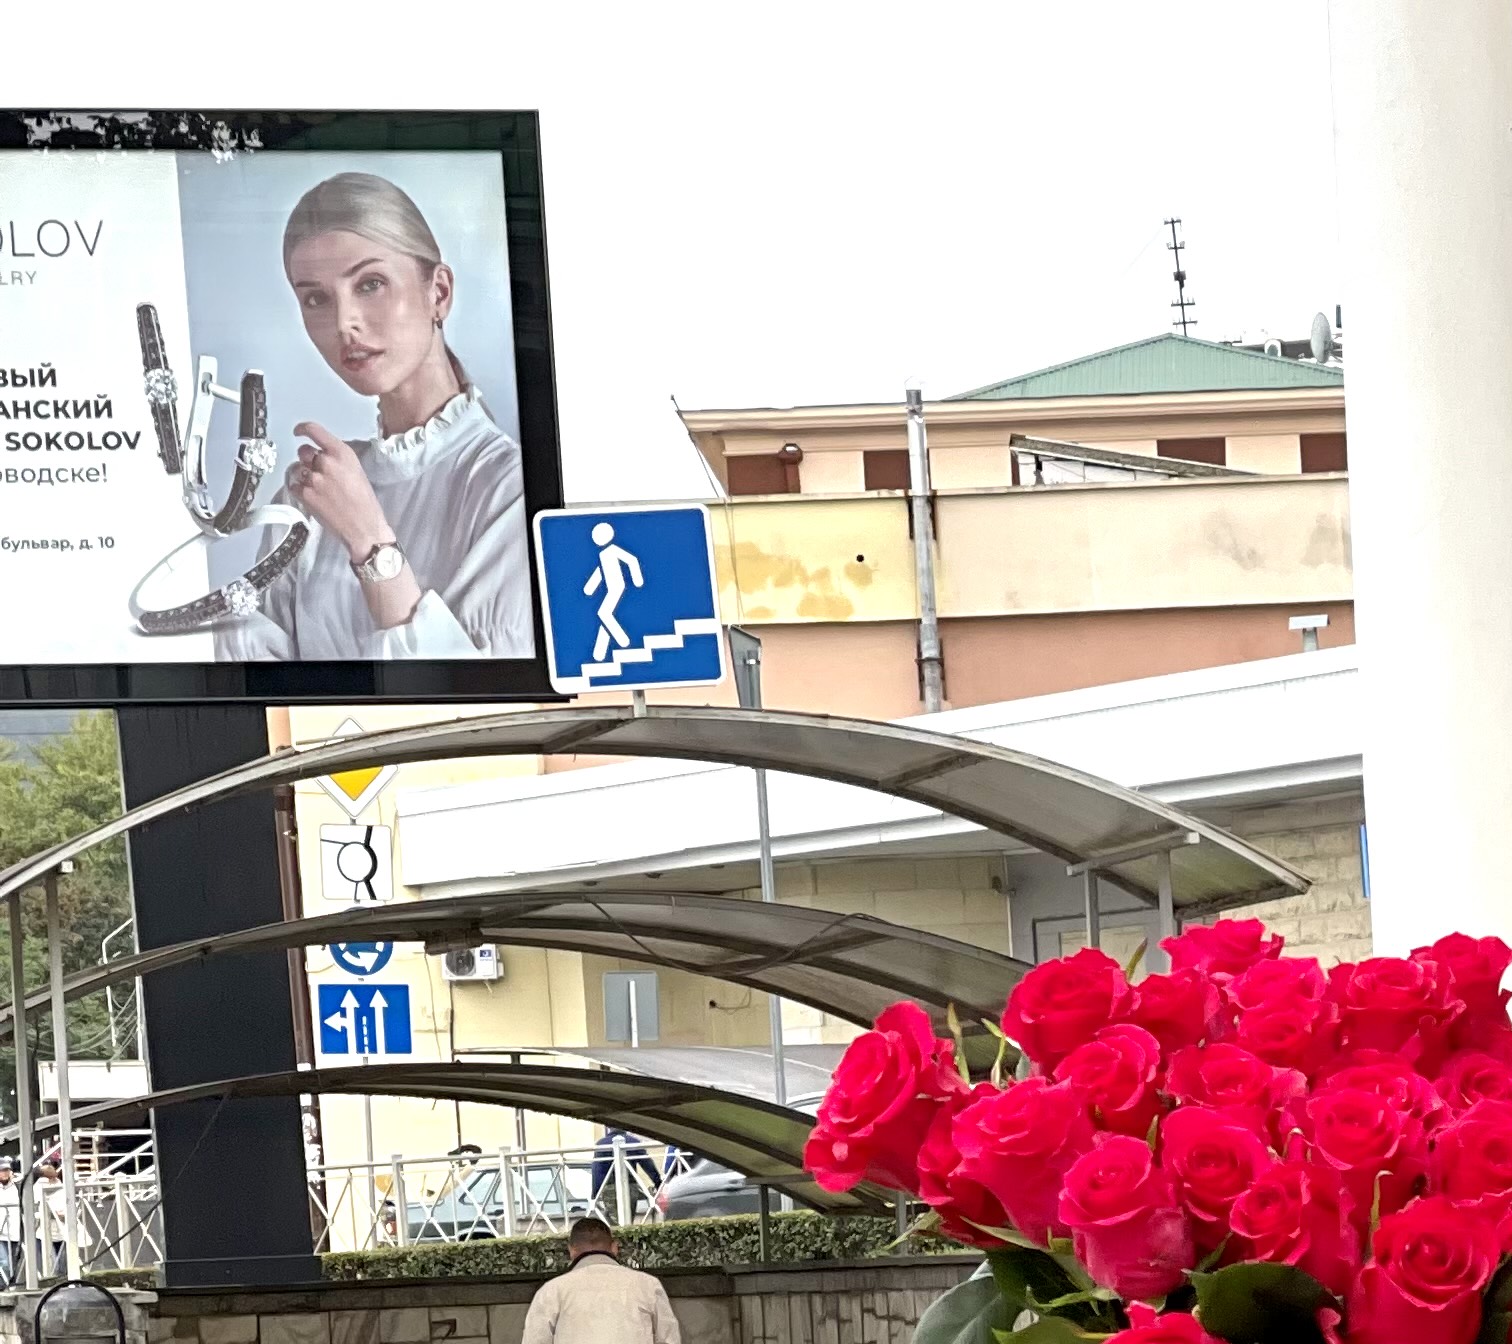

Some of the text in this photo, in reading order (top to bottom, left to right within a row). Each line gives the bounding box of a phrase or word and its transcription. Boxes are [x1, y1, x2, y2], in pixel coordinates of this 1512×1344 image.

[0, 219, 103, 257] LOV
[5, 431, 141, 451] SOKOLOV
[0, 463, 108, 486] водске!
[1, 536, 115, 553] бульвар, д. 10
